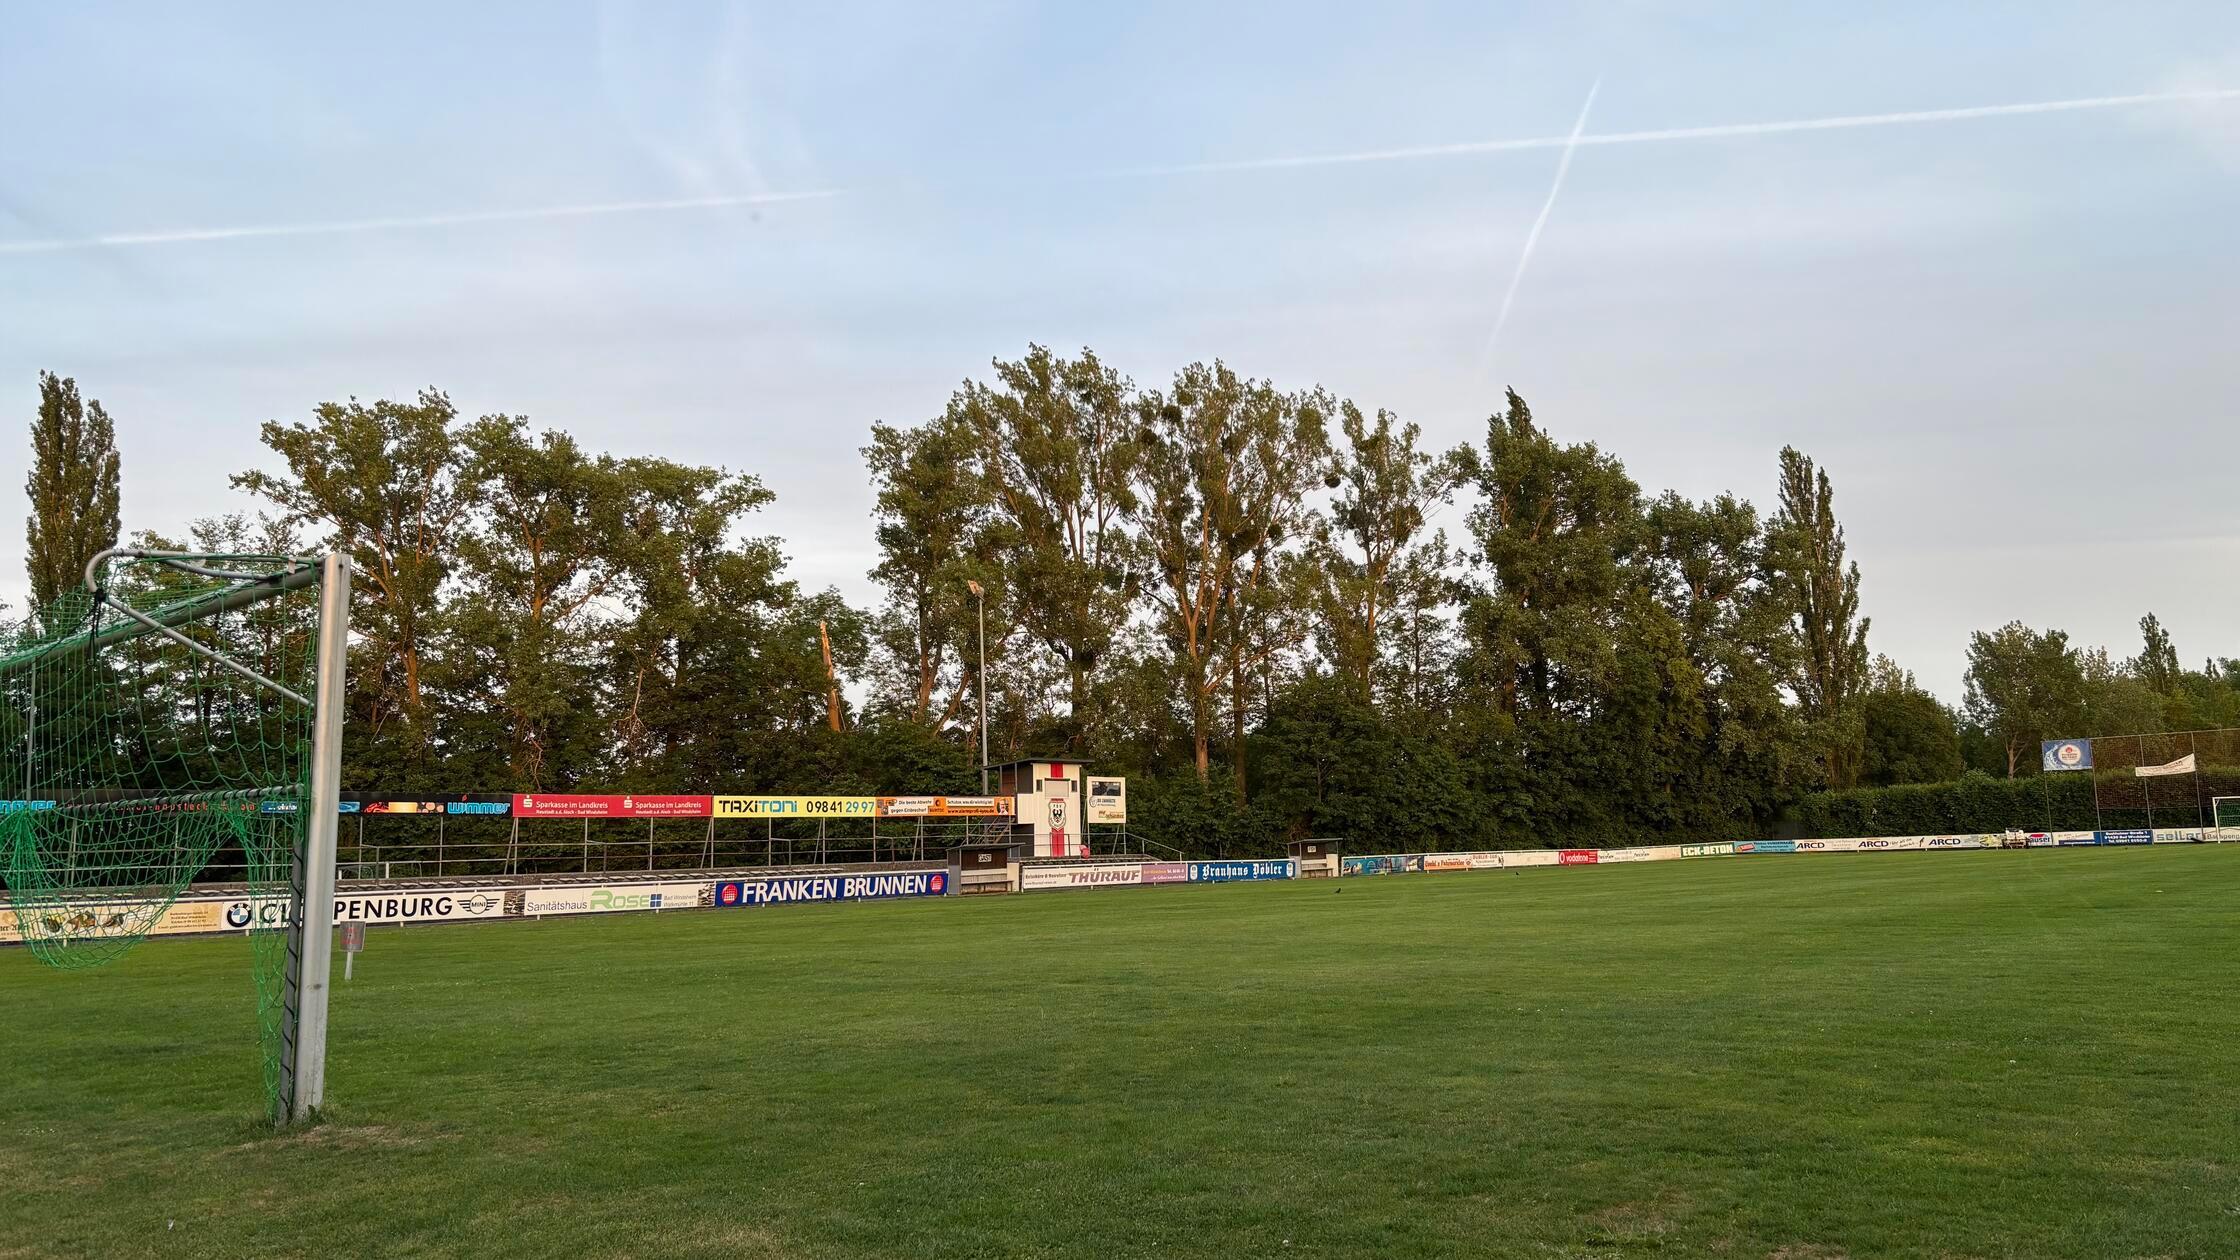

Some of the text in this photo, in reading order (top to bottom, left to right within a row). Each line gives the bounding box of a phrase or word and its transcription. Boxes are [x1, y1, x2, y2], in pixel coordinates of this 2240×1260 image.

[447, 799, 510, 814] wimmer
[535, 801, 568, 809] Sparkasse
[1928, 838, 1961, 846] ARCD
[1682, 844, 1734, 857] ECK-BETON
[1565, 854, 1589, 862] vodafone
[1068, 868, 1140, 883] THÜRAUF
[1202, 863, 1248, 880] Brauhaus
[1252, 862, 1282, 879] Döbler
[742, 875, 927, 903] FRANKEN BRUNNEN
[261, 897, 453, 923] CLPENBURG
[526, 901, 588, 912] Sanitätshaus
